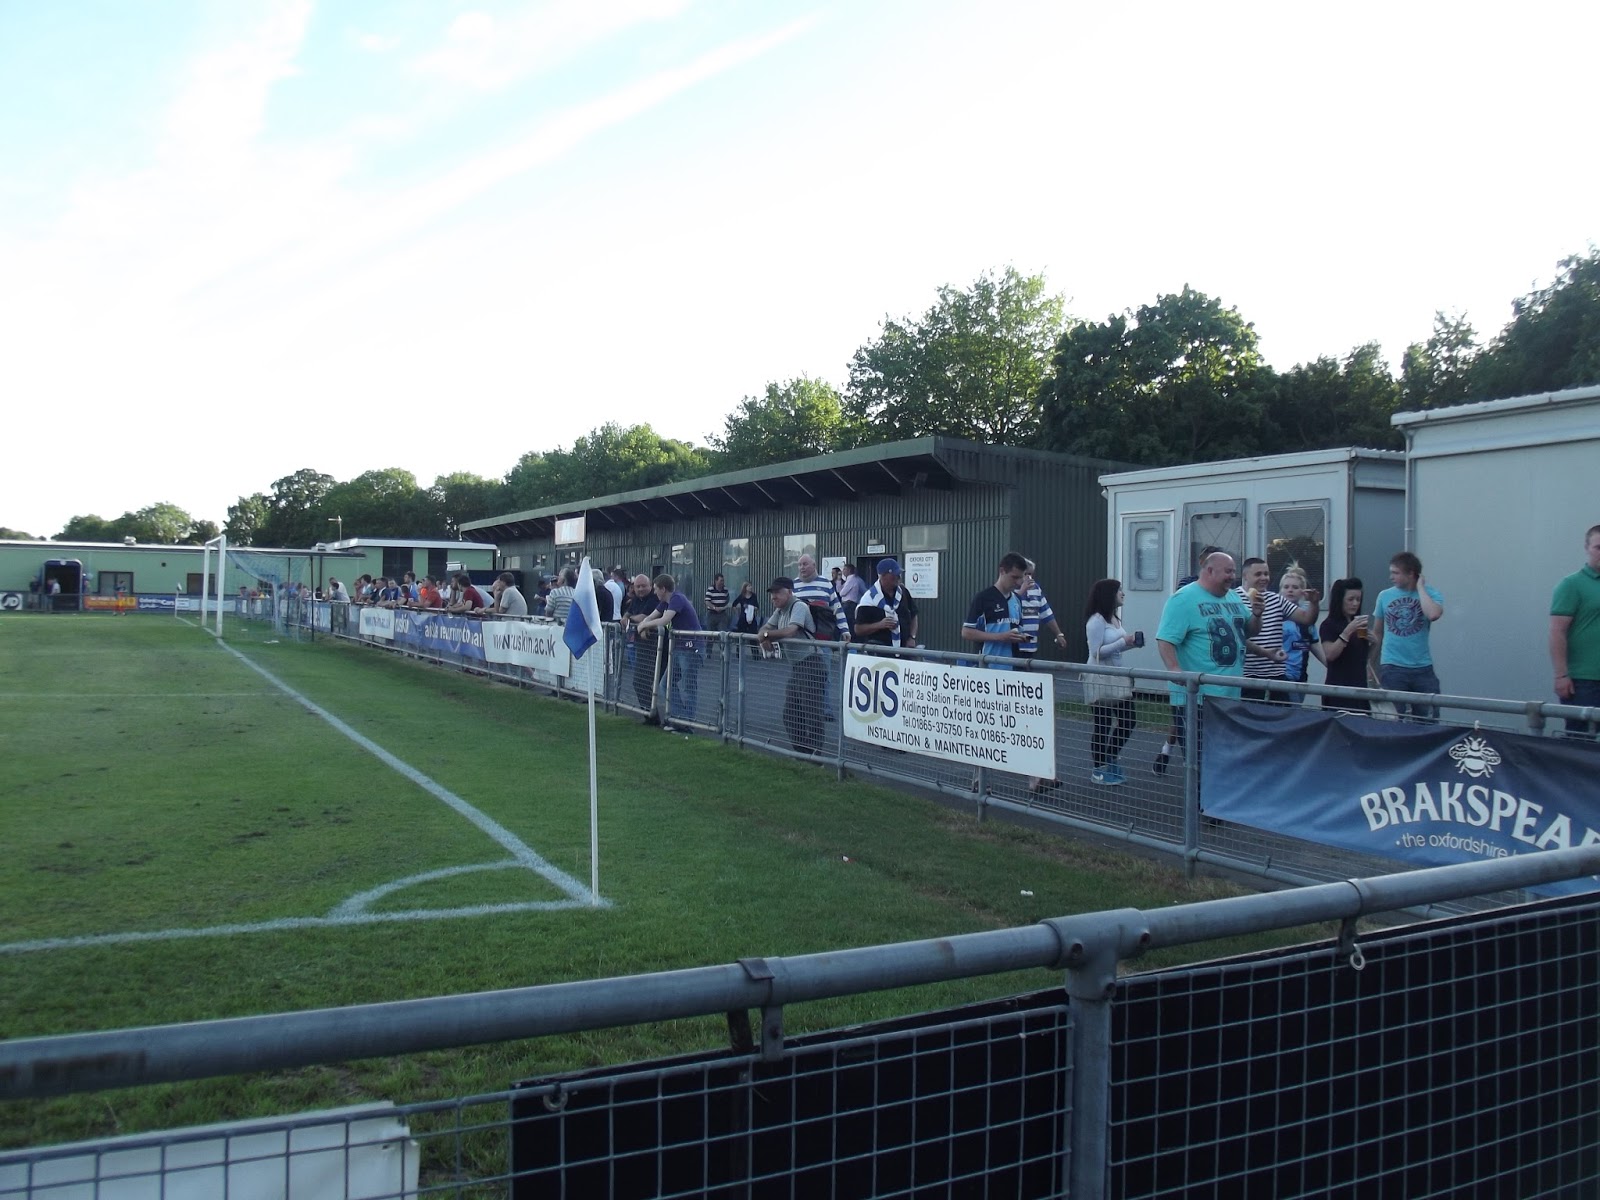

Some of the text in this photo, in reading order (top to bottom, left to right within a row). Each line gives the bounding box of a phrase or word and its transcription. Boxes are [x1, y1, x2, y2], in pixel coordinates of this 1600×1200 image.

[849, 666, 899, 718] ISIS
[903, 668, 1043, 700] Heating Services Limited
[902, 688, 1044, 716] Unit 2a Station Field Industrial Estate
[902, 700, 1016, 728] Kidlington Oxford OX5 1JD
[867, 725, 1008, 763] INSTALLATION & MAINTENANCE
[965, 726, 979, 740] Fax
[981, 728, 1045, 750] 01865-378050
[1402, 832, 1426, 849] the
[1429, 833, 1509, 858] oxfordshire
